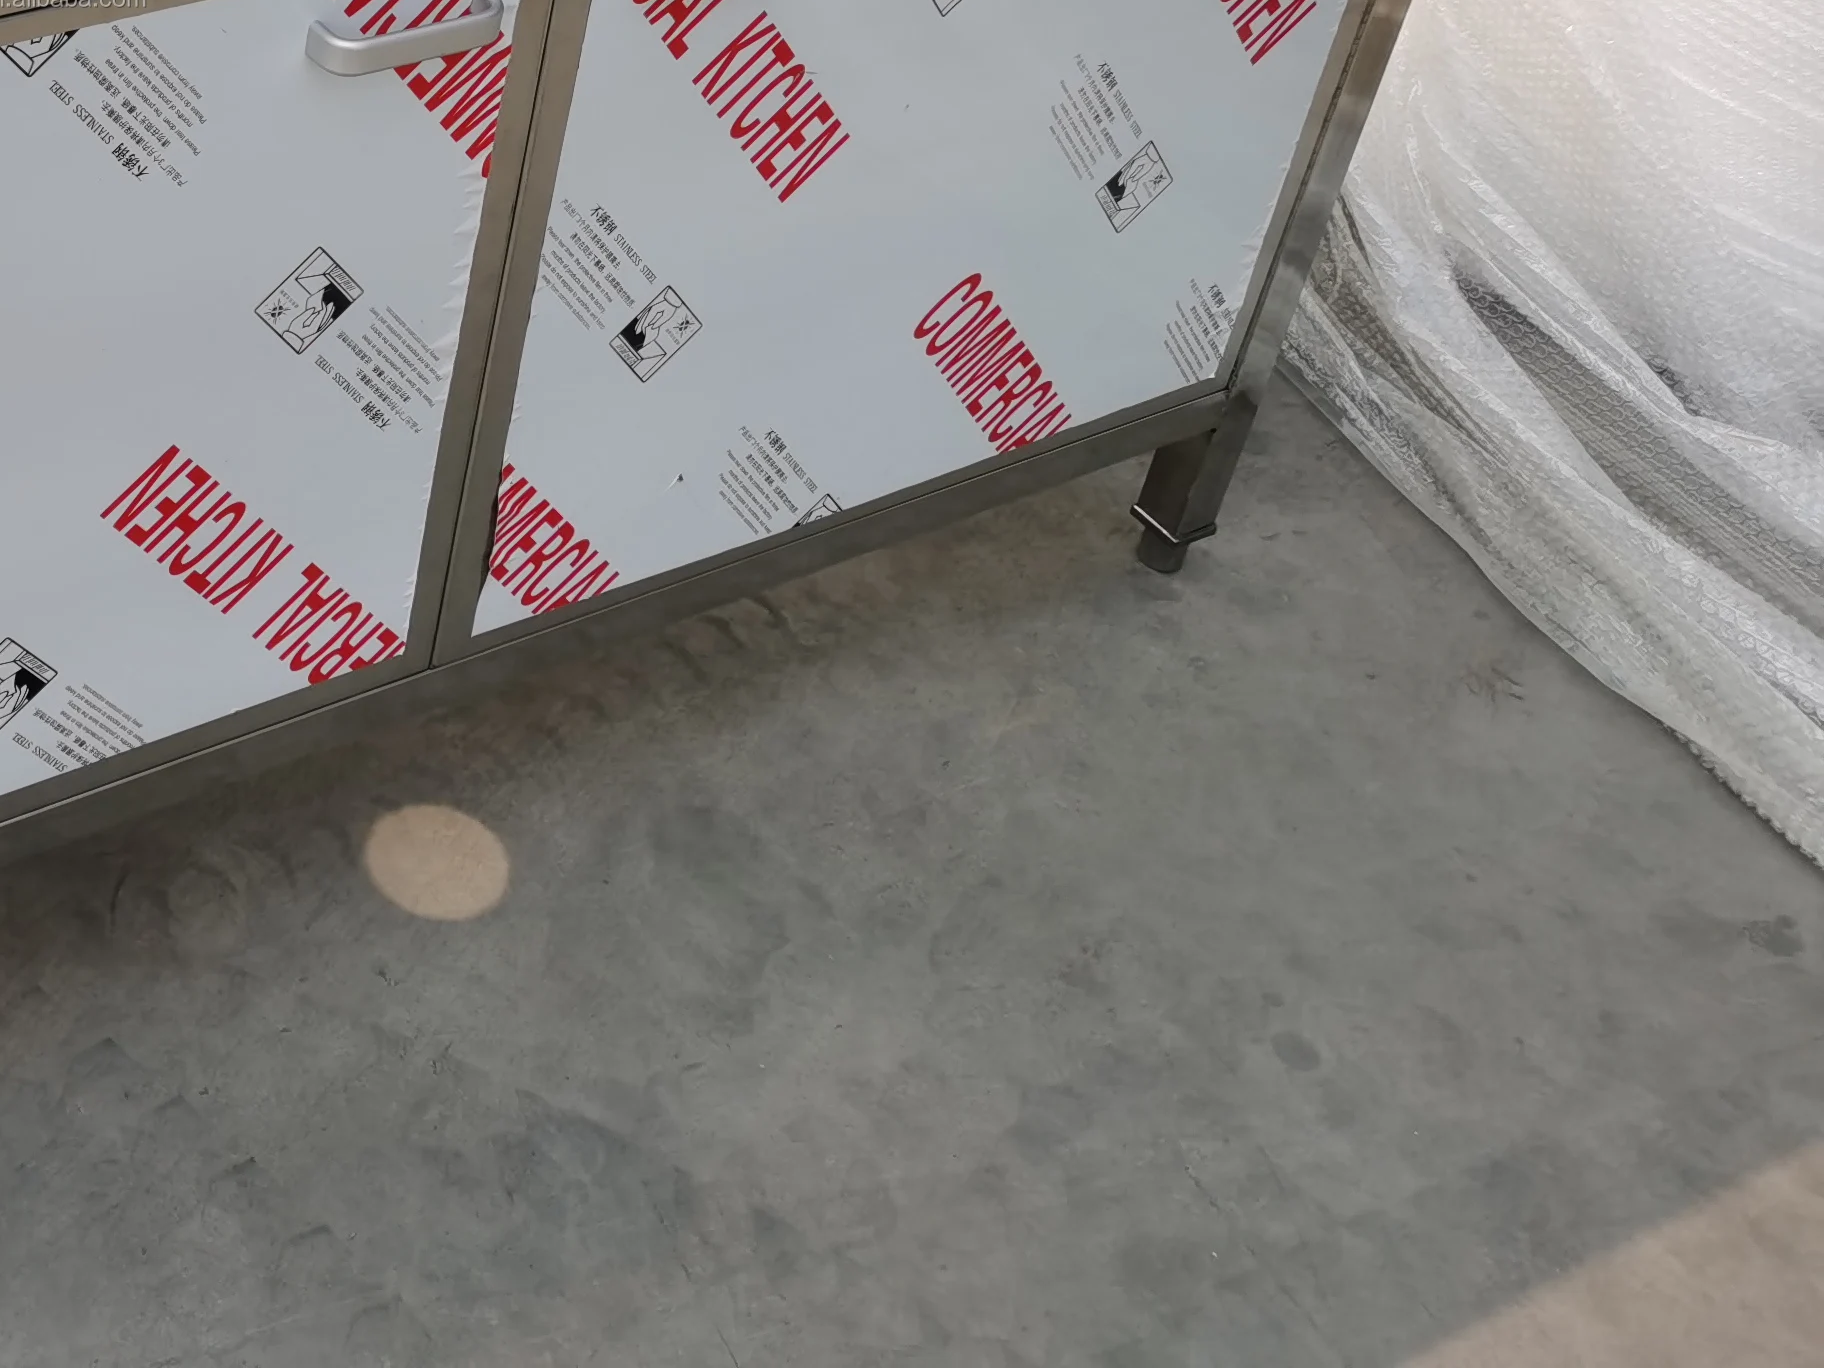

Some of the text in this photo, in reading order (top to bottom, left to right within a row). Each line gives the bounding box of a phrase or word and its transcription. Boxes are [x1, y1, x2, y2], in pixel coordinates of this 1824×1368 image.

[111, 25, 125, 40] keep
[122, 37, 134, 49] and
[105, 59, 119, 74] three
[133, 47, 155, 70] sunshine
[157, 53, 179, 76] corrosive
[130, 63, 140, 74] the
[123, 76, 133, 88] film
[138, 71, 152, 87] leave
[159, 74, 177, 92] expose
[178, 74, 190, 88] from
[132, 85, 156, 109] protective
[150, 84, 173, 105] products
[175, 91, 185, 101] not
[188, 85, 202, 100] away
[153, 107, 163, 117] the
[190, 106, 207, 124] Please
[692, 10, 850, 203] KITCHEN
[1113, 89, 1133, 122] STAINLESS
[163, 116, 176, 130] down
[175, 109, 193, 127] months
[49, 80, 149, 181] 不锈钢 STAINLESS STEEL
[184, 138, 201, 156] Please
[590, 203, 657, 285] 不锈钢 STAINLESS STEEL
[547, 226, 559, 241] Please
[578, 265, 596, 283] protective
[565, 268, 581, 285] products
[579, 282, 590, 295] leave
[560, 279, 574, 293] expose
[575, 296, 591, 313] sunshine
[589, 312, 598, 321] and
[314, 354, 391, 432] 不锈钢 STAINLESS STEEL
[782, 452, 806, 480] STAINLESS
[803, 477, 818, 494] STEEL
[100, 444, 406, 686] ERCIAL KITCHEN
[12, 732, 68, 772] STAINLESS STEEL
